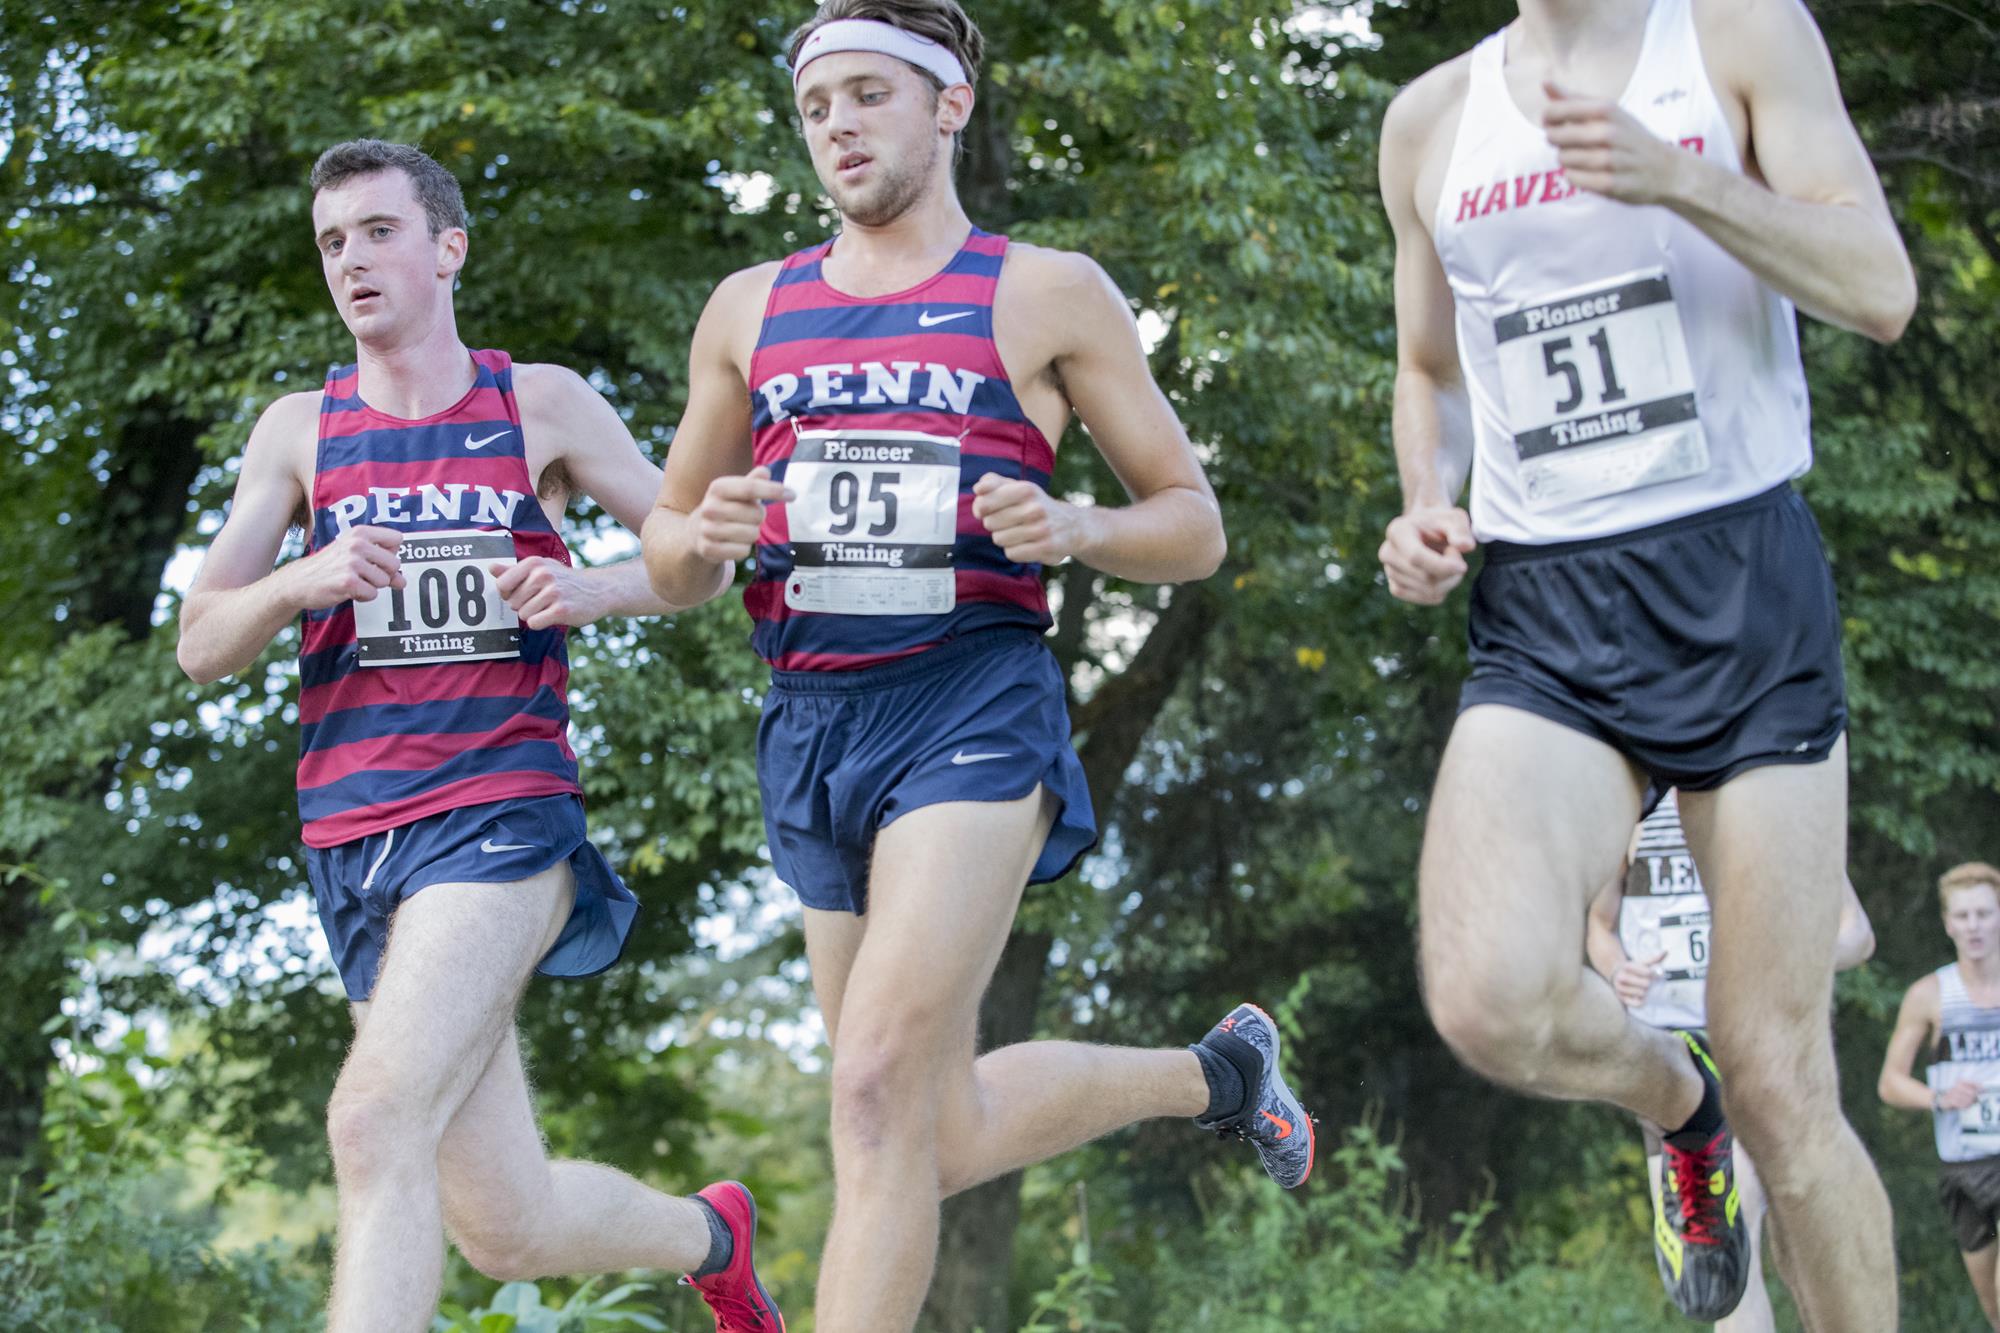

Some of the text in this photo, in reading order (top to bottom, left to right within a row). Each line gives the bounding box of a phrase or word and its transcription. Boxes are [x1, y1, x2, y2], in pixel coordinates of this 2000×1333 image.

[1524, 293, 1621, 333] Pioneer
[1542, 327, 1627, 414] 51
[759, 361, 986, 424] PENN
[1551, 409, 1645, 447] Timing
[824, 441, 914, 462] Pioneer
[328, 483, 526, 541] PENN
[828, 471, 901, 537] 95
[396, 542, 473, 560] Pioneer
[821, 543, 904, 567] Timing
[387, 565, 487, 632] 108
[400, 634, 476, 653] Timing
[1648, 856, 1704, 896] LE
[1689, 930, 1711, 962] 6
